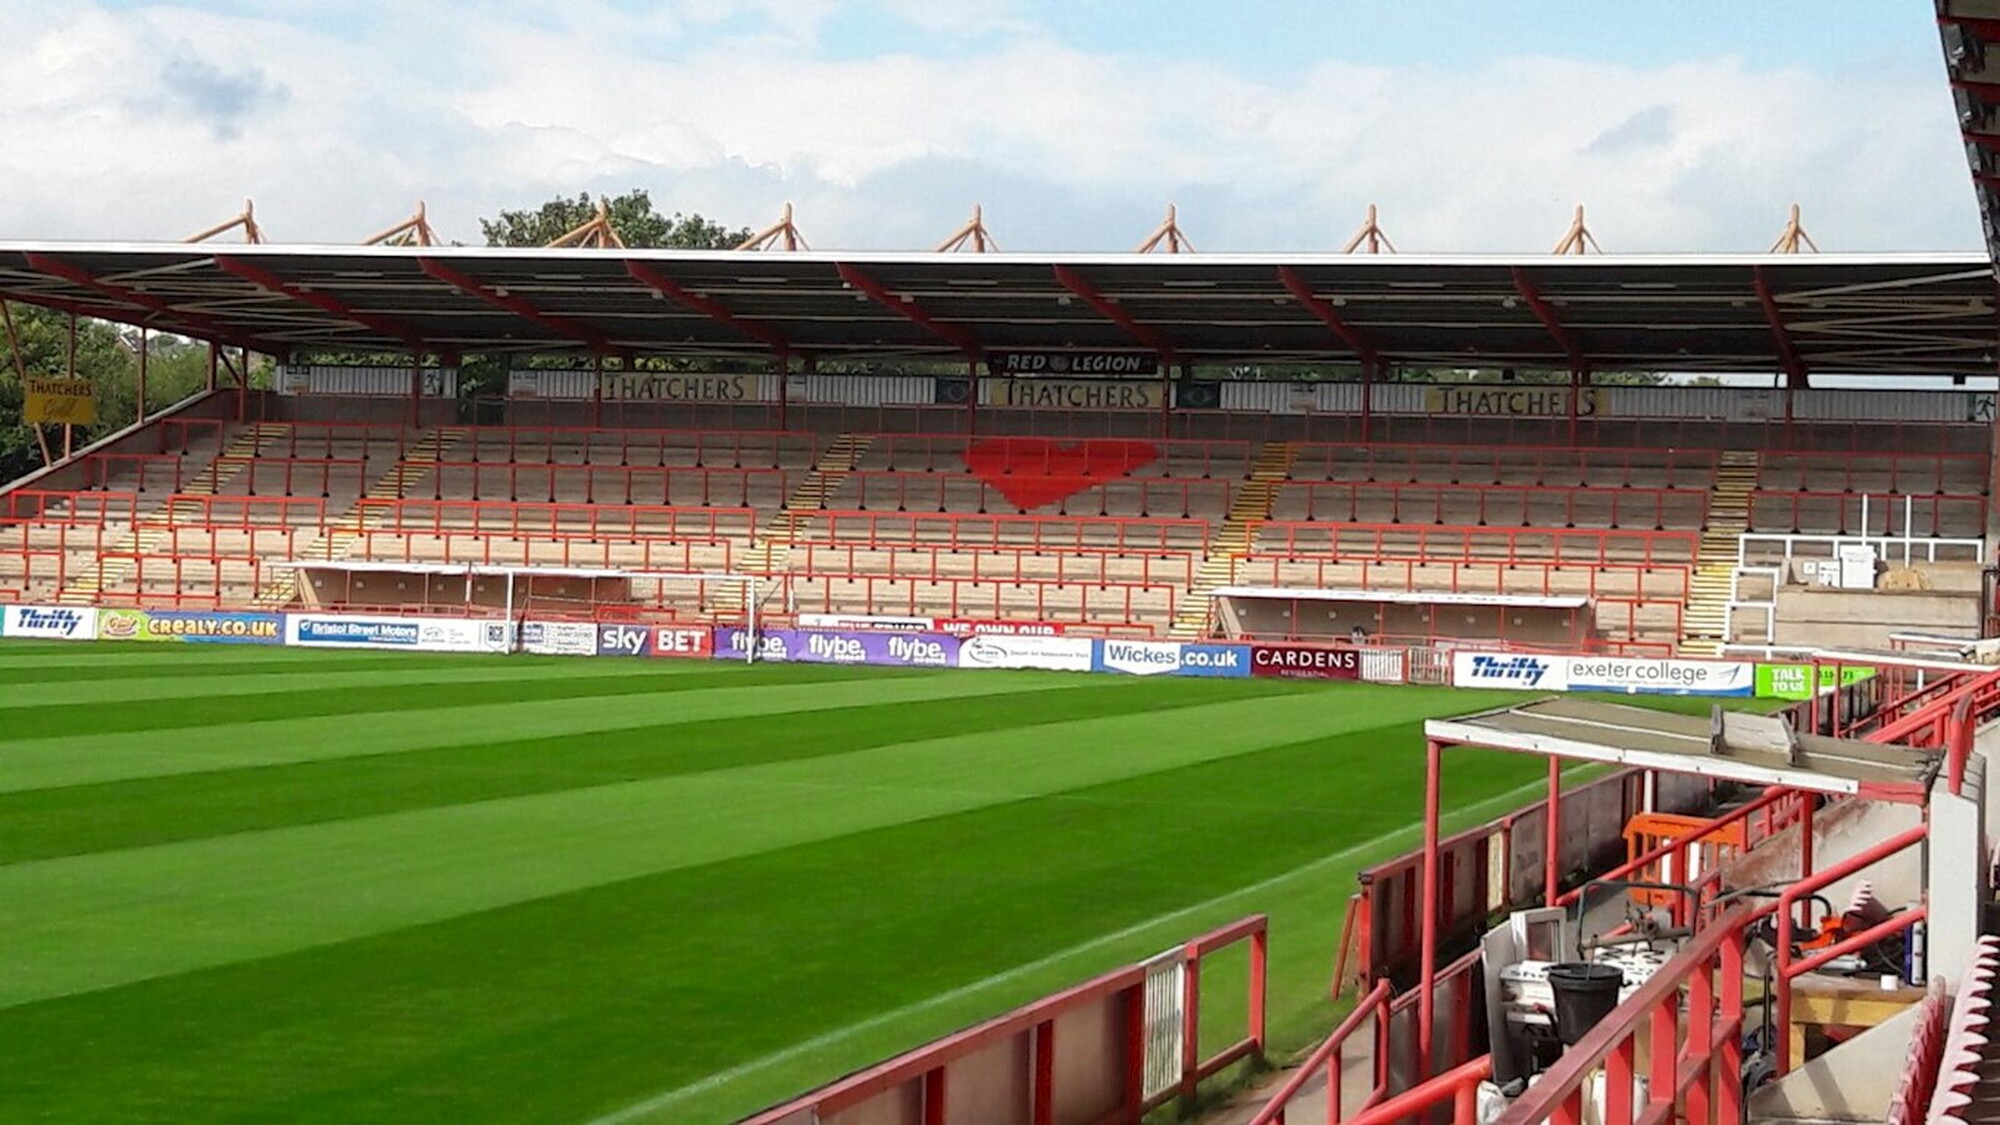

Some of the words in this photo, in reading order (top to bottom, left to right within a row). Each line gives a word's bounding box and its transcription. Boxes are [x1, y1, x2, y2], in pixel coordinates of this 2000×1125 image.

[1007, 354, 1046, 369] RED
[1072, 355, 1140, 371] LEGION
[28, 380, 92, 397] THATCHERS
[603, 374, 744, 400] THATCHERS
[1001, 380, 1149, 407] THATCHERS
[18, 608, 82, 636] Thrifty
[381, 625, 417, 637] Motors
[602, 624, 647, 655] sky
[657, 629, 707, 653] BET
[1255, 649, 1355, 668] CARDENS
[1471, 656, 1549, 686] Thrifty
[1573, 662, 1631, 678] exeter
[1635, 661, 1707, 686] college
[1771, 667, 1806, 681] TALK
[1771, 681, 1787, 693] TO
[1788, 682, 1805, 694] US
